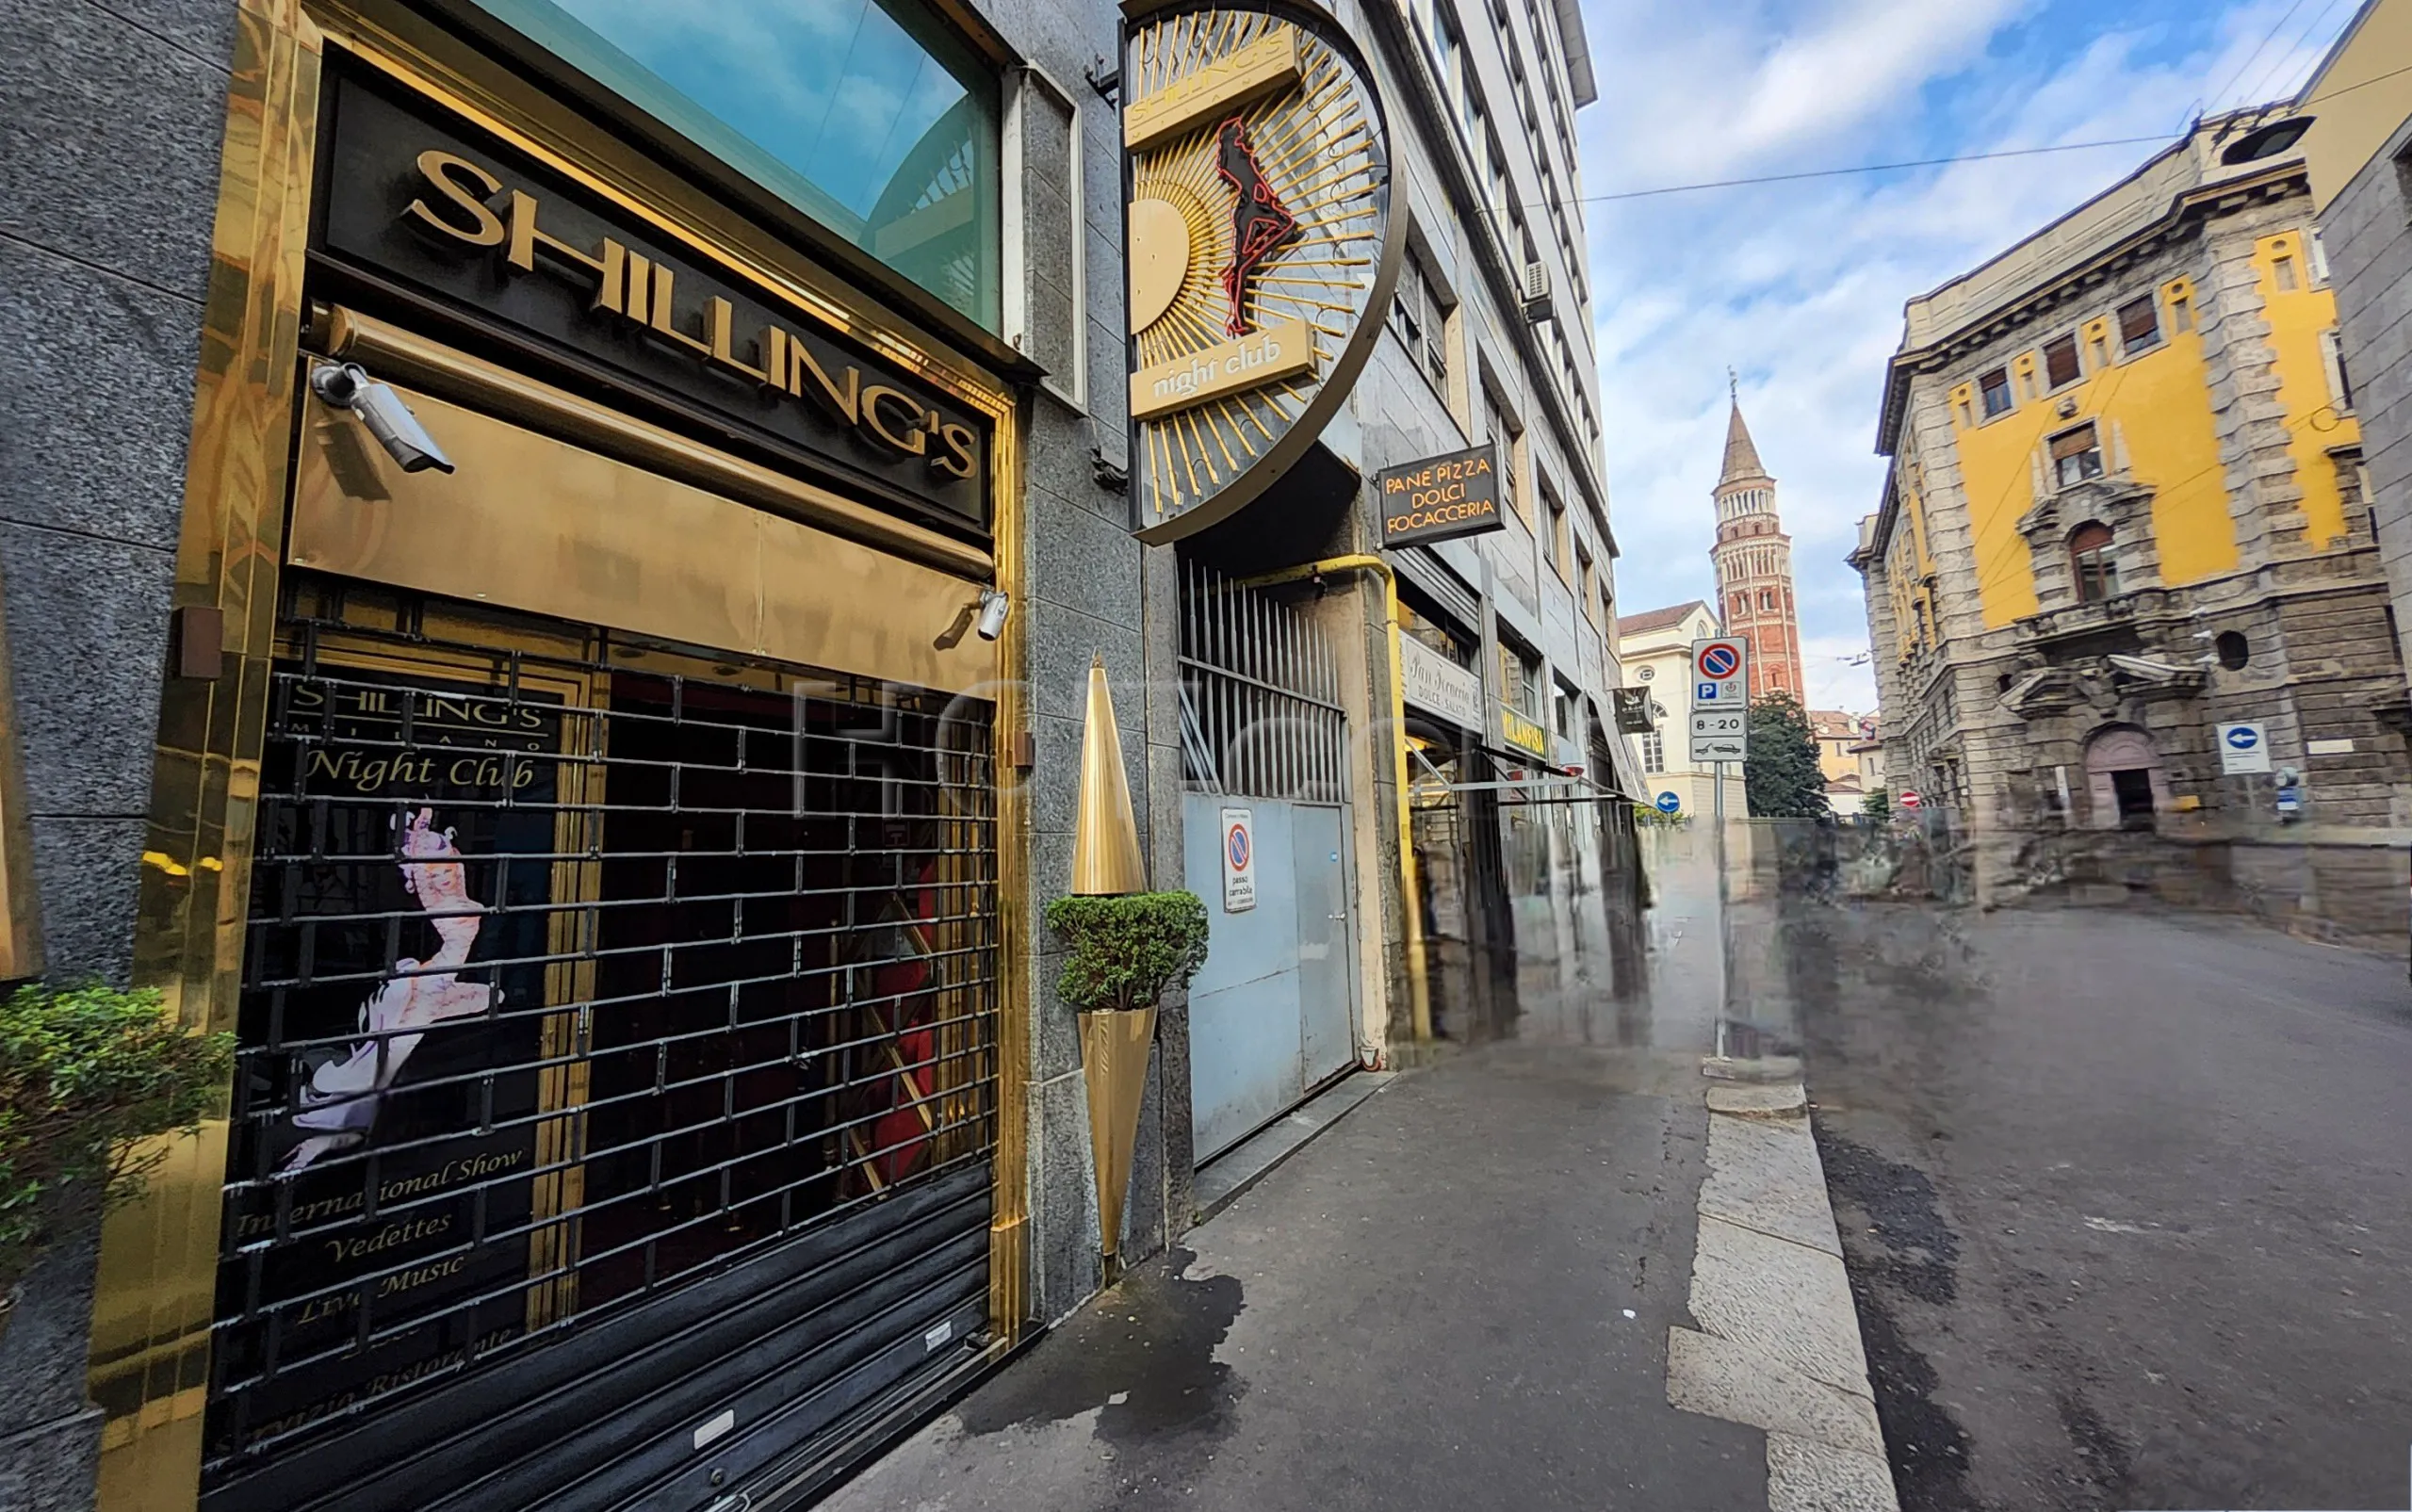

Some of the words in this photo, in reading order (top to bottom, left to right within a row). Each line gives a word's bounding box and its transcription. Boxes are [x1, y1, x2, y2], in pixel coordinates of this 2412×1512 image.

[1131, 33, 1284, 122] SHILLING'S
[400, 149, 977, 480] SHILLING'S
[1152, 357, 1219, 398] night
[1225, 333, 1282, 375] club
[1386, 470, 1432, 495] PANE
[1437, 458, 1491, 483] PIZZA
[1411, 483, 1466, 510] DOLCI
[1387, 499, 1496, 534] FOCACCERIA
[1418, 685, 1442, 706] DOLCE
[1702, 685, 1714, 698] P
[306, 750, 435, 791] Night
[450, 756, 534, 789] Club
[236, 1161, 460, 1237] Inernaional
[457, 1146, 524, 1181] Show
[325, 1212, 453, 1262] Vedettes
[377, 1256, 466, 1299] Music
